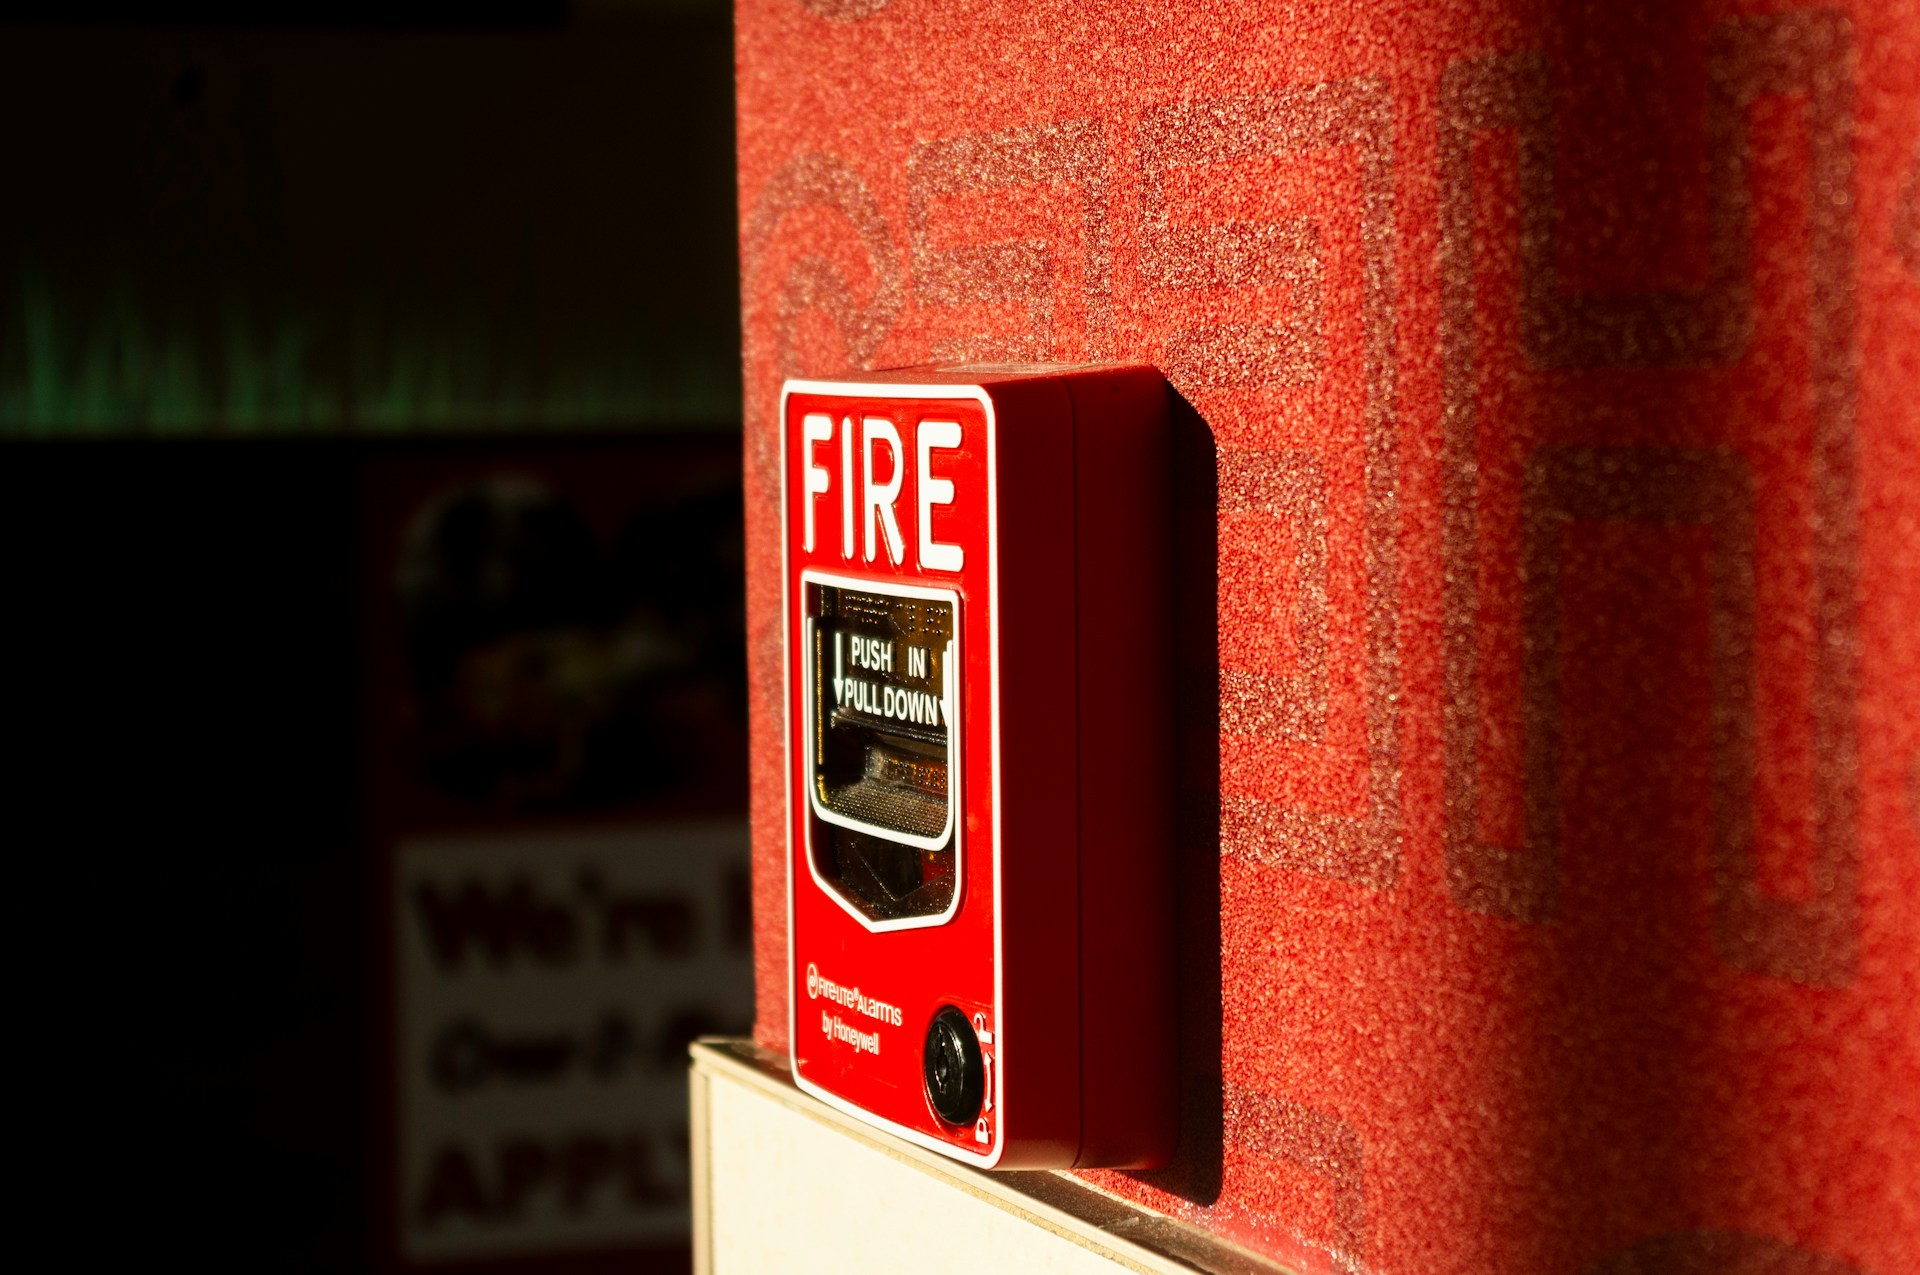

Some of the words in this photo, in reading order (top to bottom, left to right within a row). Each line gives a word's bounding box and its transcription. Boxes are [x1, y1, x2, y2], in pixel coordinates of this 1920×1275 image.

[803, 413, 964, 573] FIRE
[851, 636, 892, 673] PUSH
[908, 646, 926, 680] IN
[845, 678, 882, 716] PULL
[884, 686, 938, 727] DOWN
[822, 1010, 833, 1041] by
[833, 1015, 879, 1055] Honeywell
